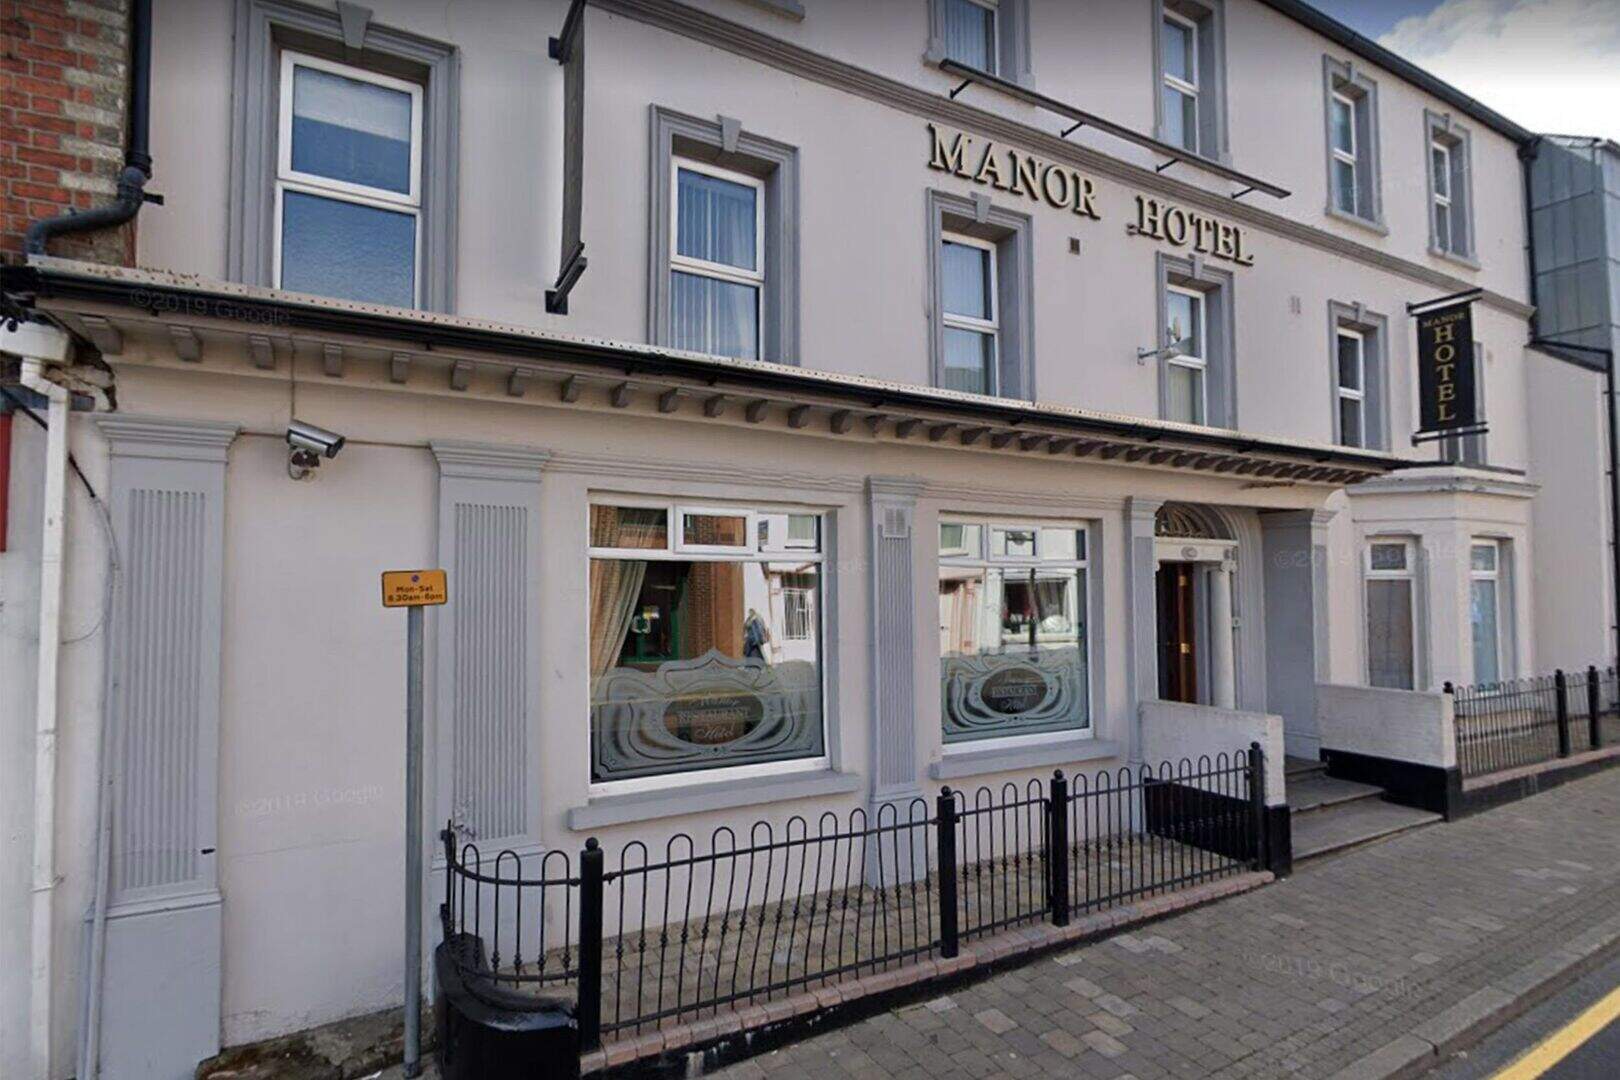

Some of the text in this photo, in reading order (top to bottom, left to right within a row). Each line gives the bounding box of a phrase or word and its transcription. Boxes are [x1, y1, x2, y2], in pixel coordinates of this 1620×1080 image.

[927, 122, 1100, 221] MANOR
[1134, 194, 1254, 266] HOTEL
[1435, 326, 1455, 421] HOTEL
